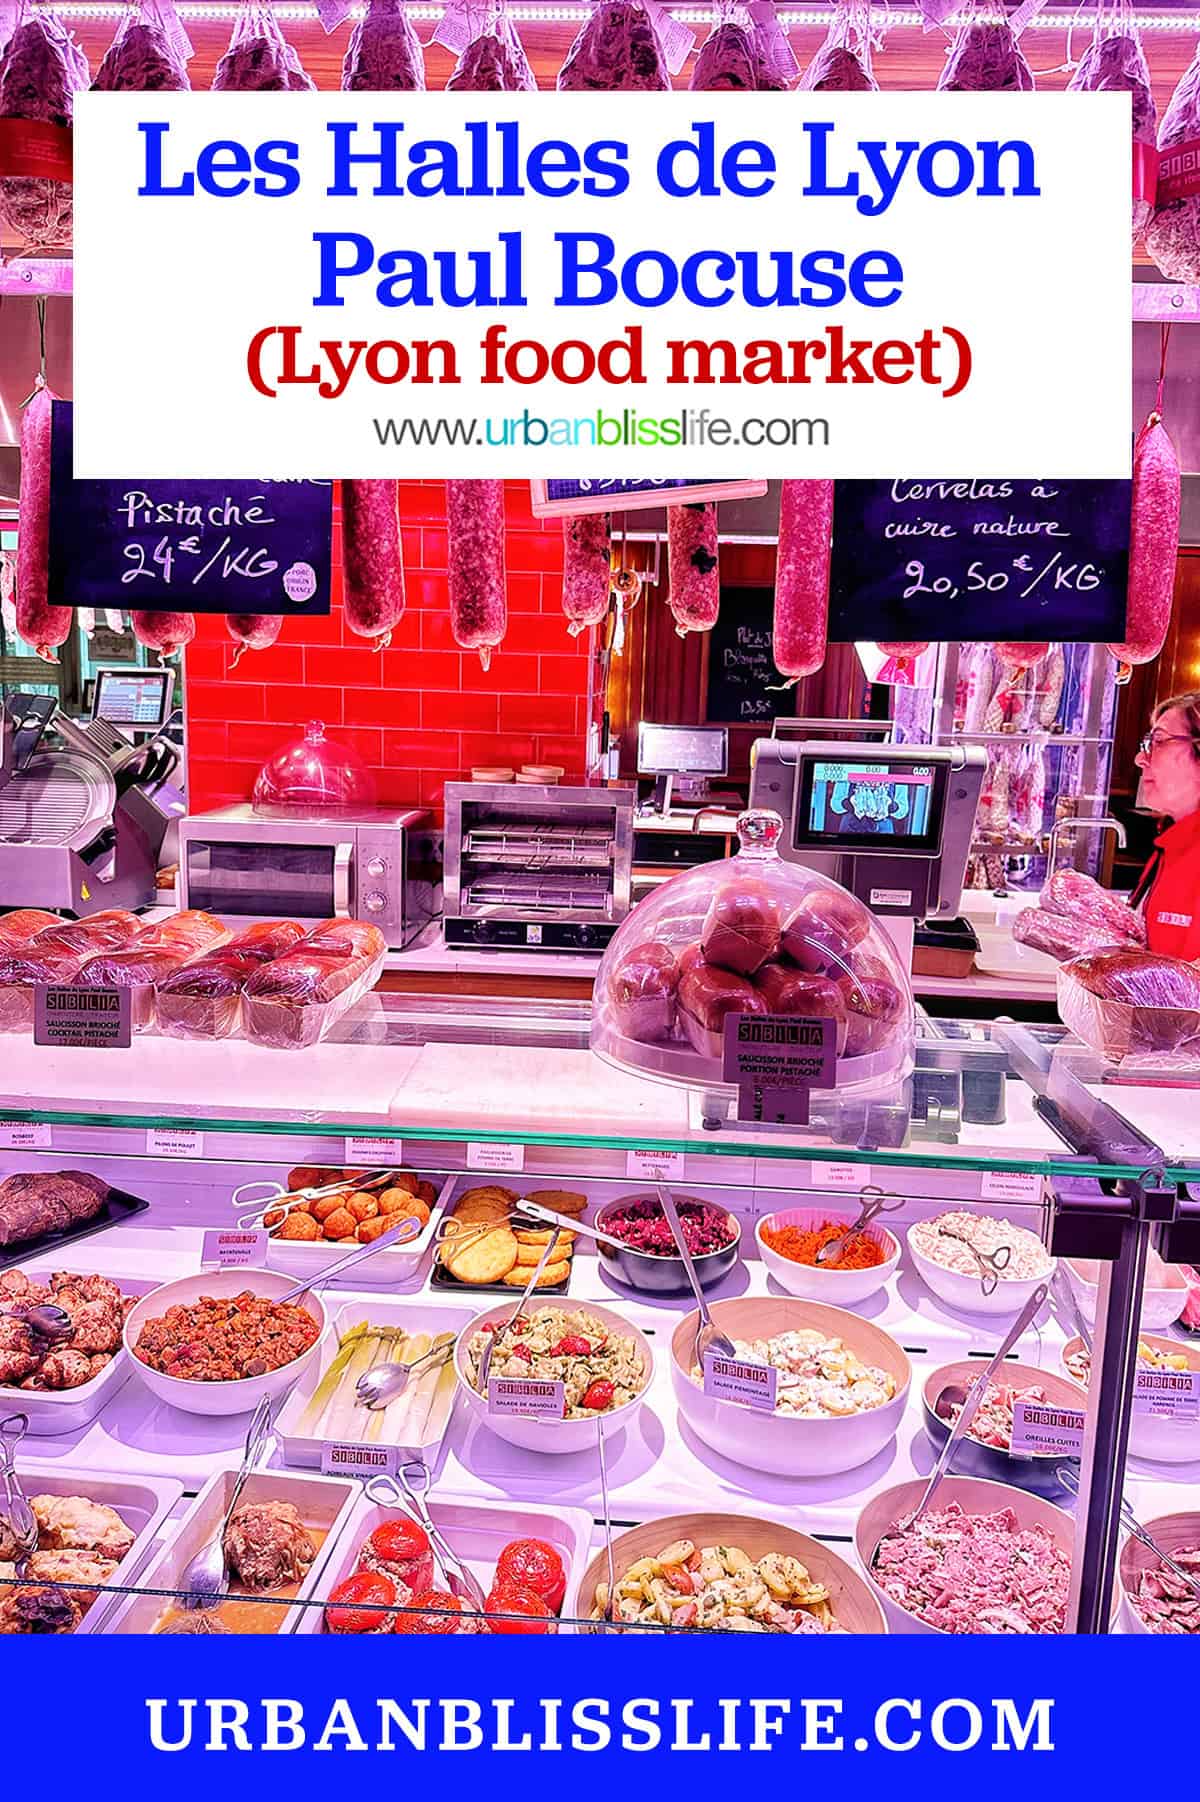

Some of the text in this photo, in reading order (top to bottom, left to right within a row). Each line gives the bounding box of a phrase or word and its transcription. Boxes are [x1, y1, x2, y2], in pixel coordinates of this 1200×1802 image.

[885, 515, 1071, 539] cuire nature
[47, 993, 120, 1011] SIBILIA
[47, 1020, 87, 1028] SAUCISSON
[48, 1029, 82, 1037] COCKTAIL
[739, 1023, 823, 1045] SIBILIA
[738, 1054, 785, 1064] SAUCISSON
[740, 1065, 779, 1074] PORTION
[713, 1361, 768, 1384] SIBILIA
[1138, 1375, 1192, 1390] SIBILIA
[497, 1384, 555, 1397] SIBILIA
[1024, 1410, 1084, 1430] SIBILIA
[1025, 1434, 1080, 1447] OREILLES CUITES
[332, 1450, 387, 1466] SIBILIA
